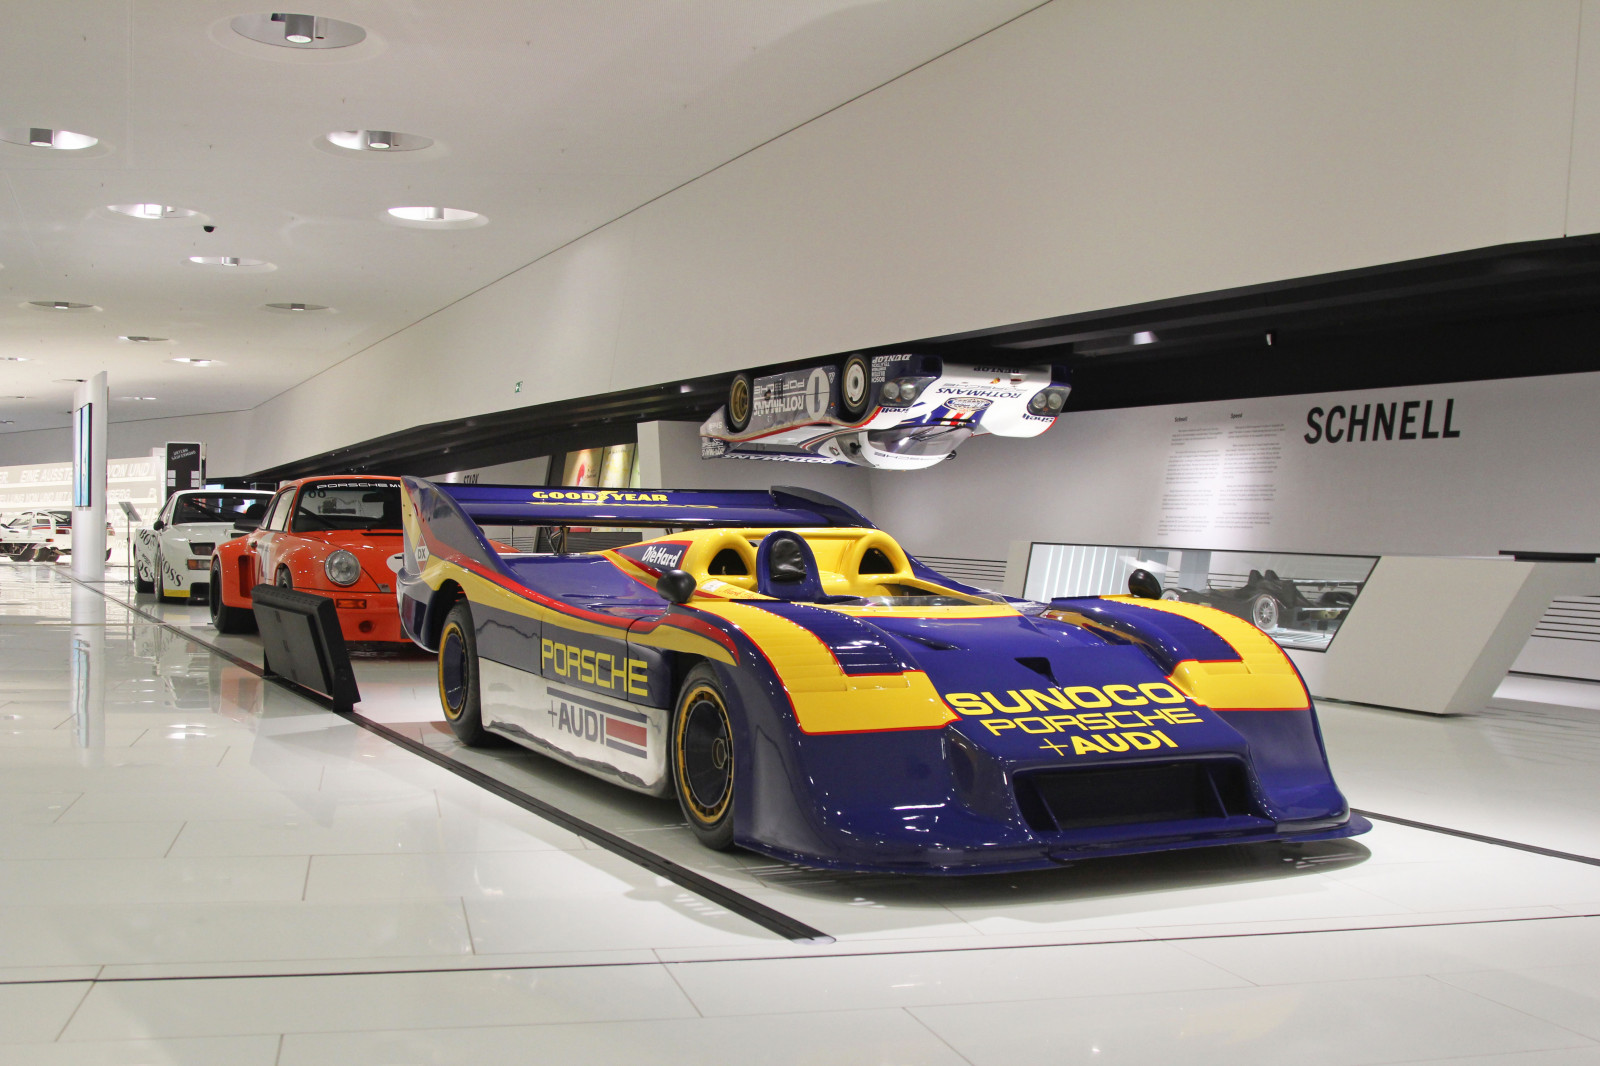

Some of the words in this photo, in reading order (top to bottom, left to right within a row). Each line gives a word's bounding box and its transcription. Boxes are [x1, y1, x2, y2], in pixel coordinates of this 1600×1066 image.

[872, 354, 912, 363] DUNLOP
[935, 387, 1021, 400] ROTHMANS
[753, 395, 805, 417] ROTHMANS
[1021, 412, 1054, 423] Shell
[1303, 398, 1461, 445] SCHNELL
[722, 453, 836, 465] ROTHMANS
[316, 482, 388, 490] PORSCHE
[532, 490, 668, 503] GOODYEAR
[417, 547, 426, 559] DX
[641, 545, 683, 568] DieHard
[541, 638, 648, 697] PORSCHE
[945, 682, 1187, 716] SUNOCO
[547, 699, 605, 746] +AUDI
[979, 707, 1205, 737] PORSCHE
[1039, 729, 1180, 757] +AUDI
